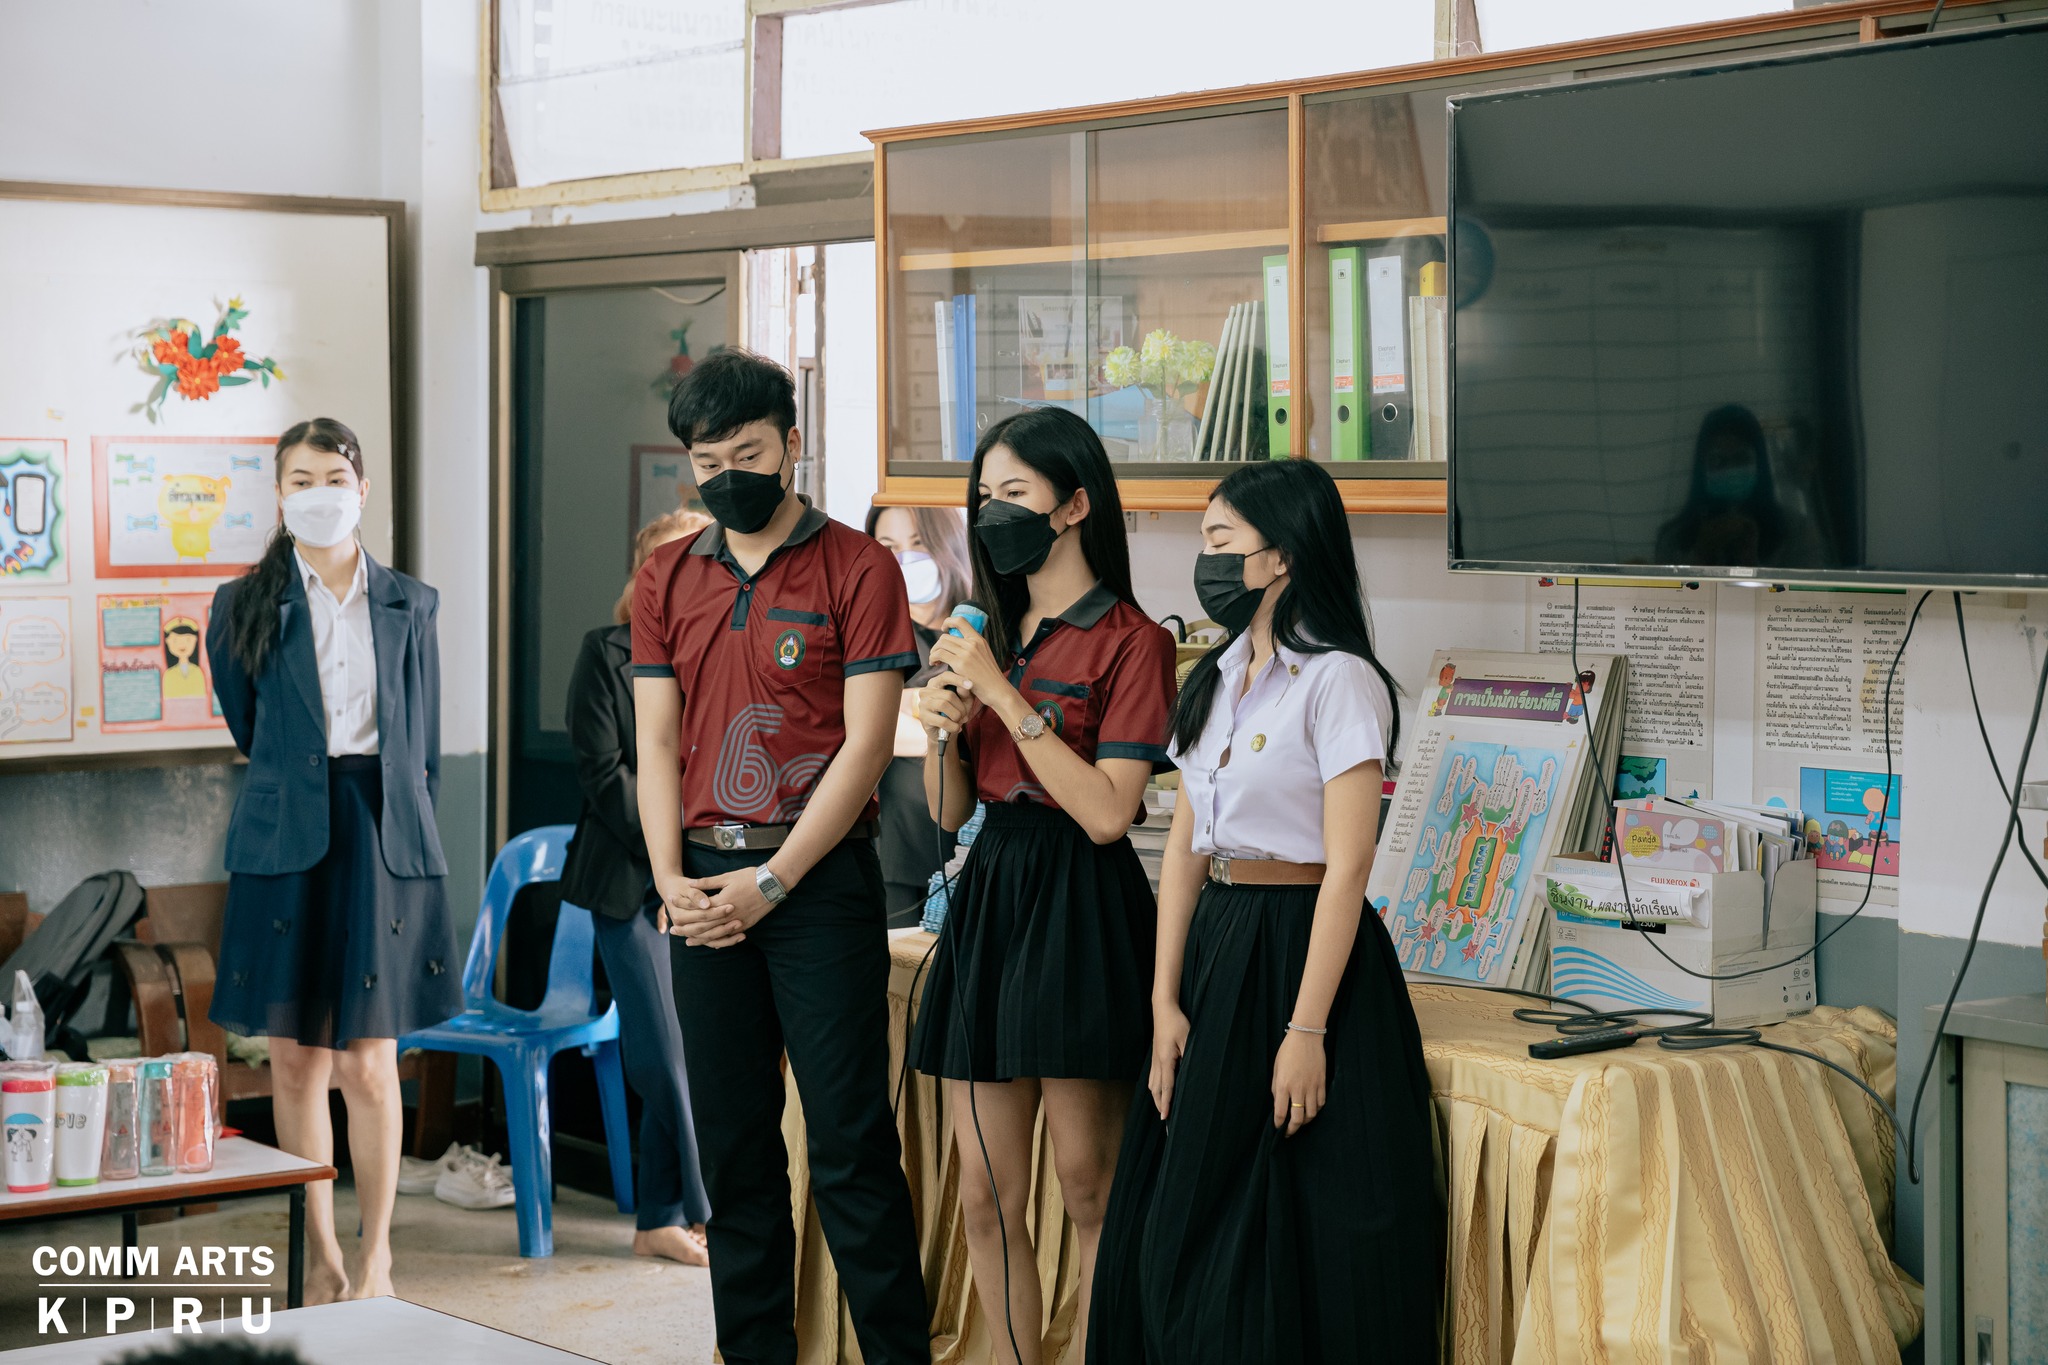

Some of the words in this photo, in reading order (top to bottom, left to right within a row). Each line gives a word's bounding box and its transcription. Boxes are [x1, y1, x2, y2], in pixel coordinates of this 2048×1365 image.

[1454, 686, 1563, 712] การเป็นนักเรียนที่ดี
[1631, 833, 1657, 844] Panda
[1464, 845, 1488, 900] พยาบาล
[1555, 863, 1588, 875] Premium
[1650, 876, 1665, 884] FUJI
[1666, 878, 1688, 887] xerox
